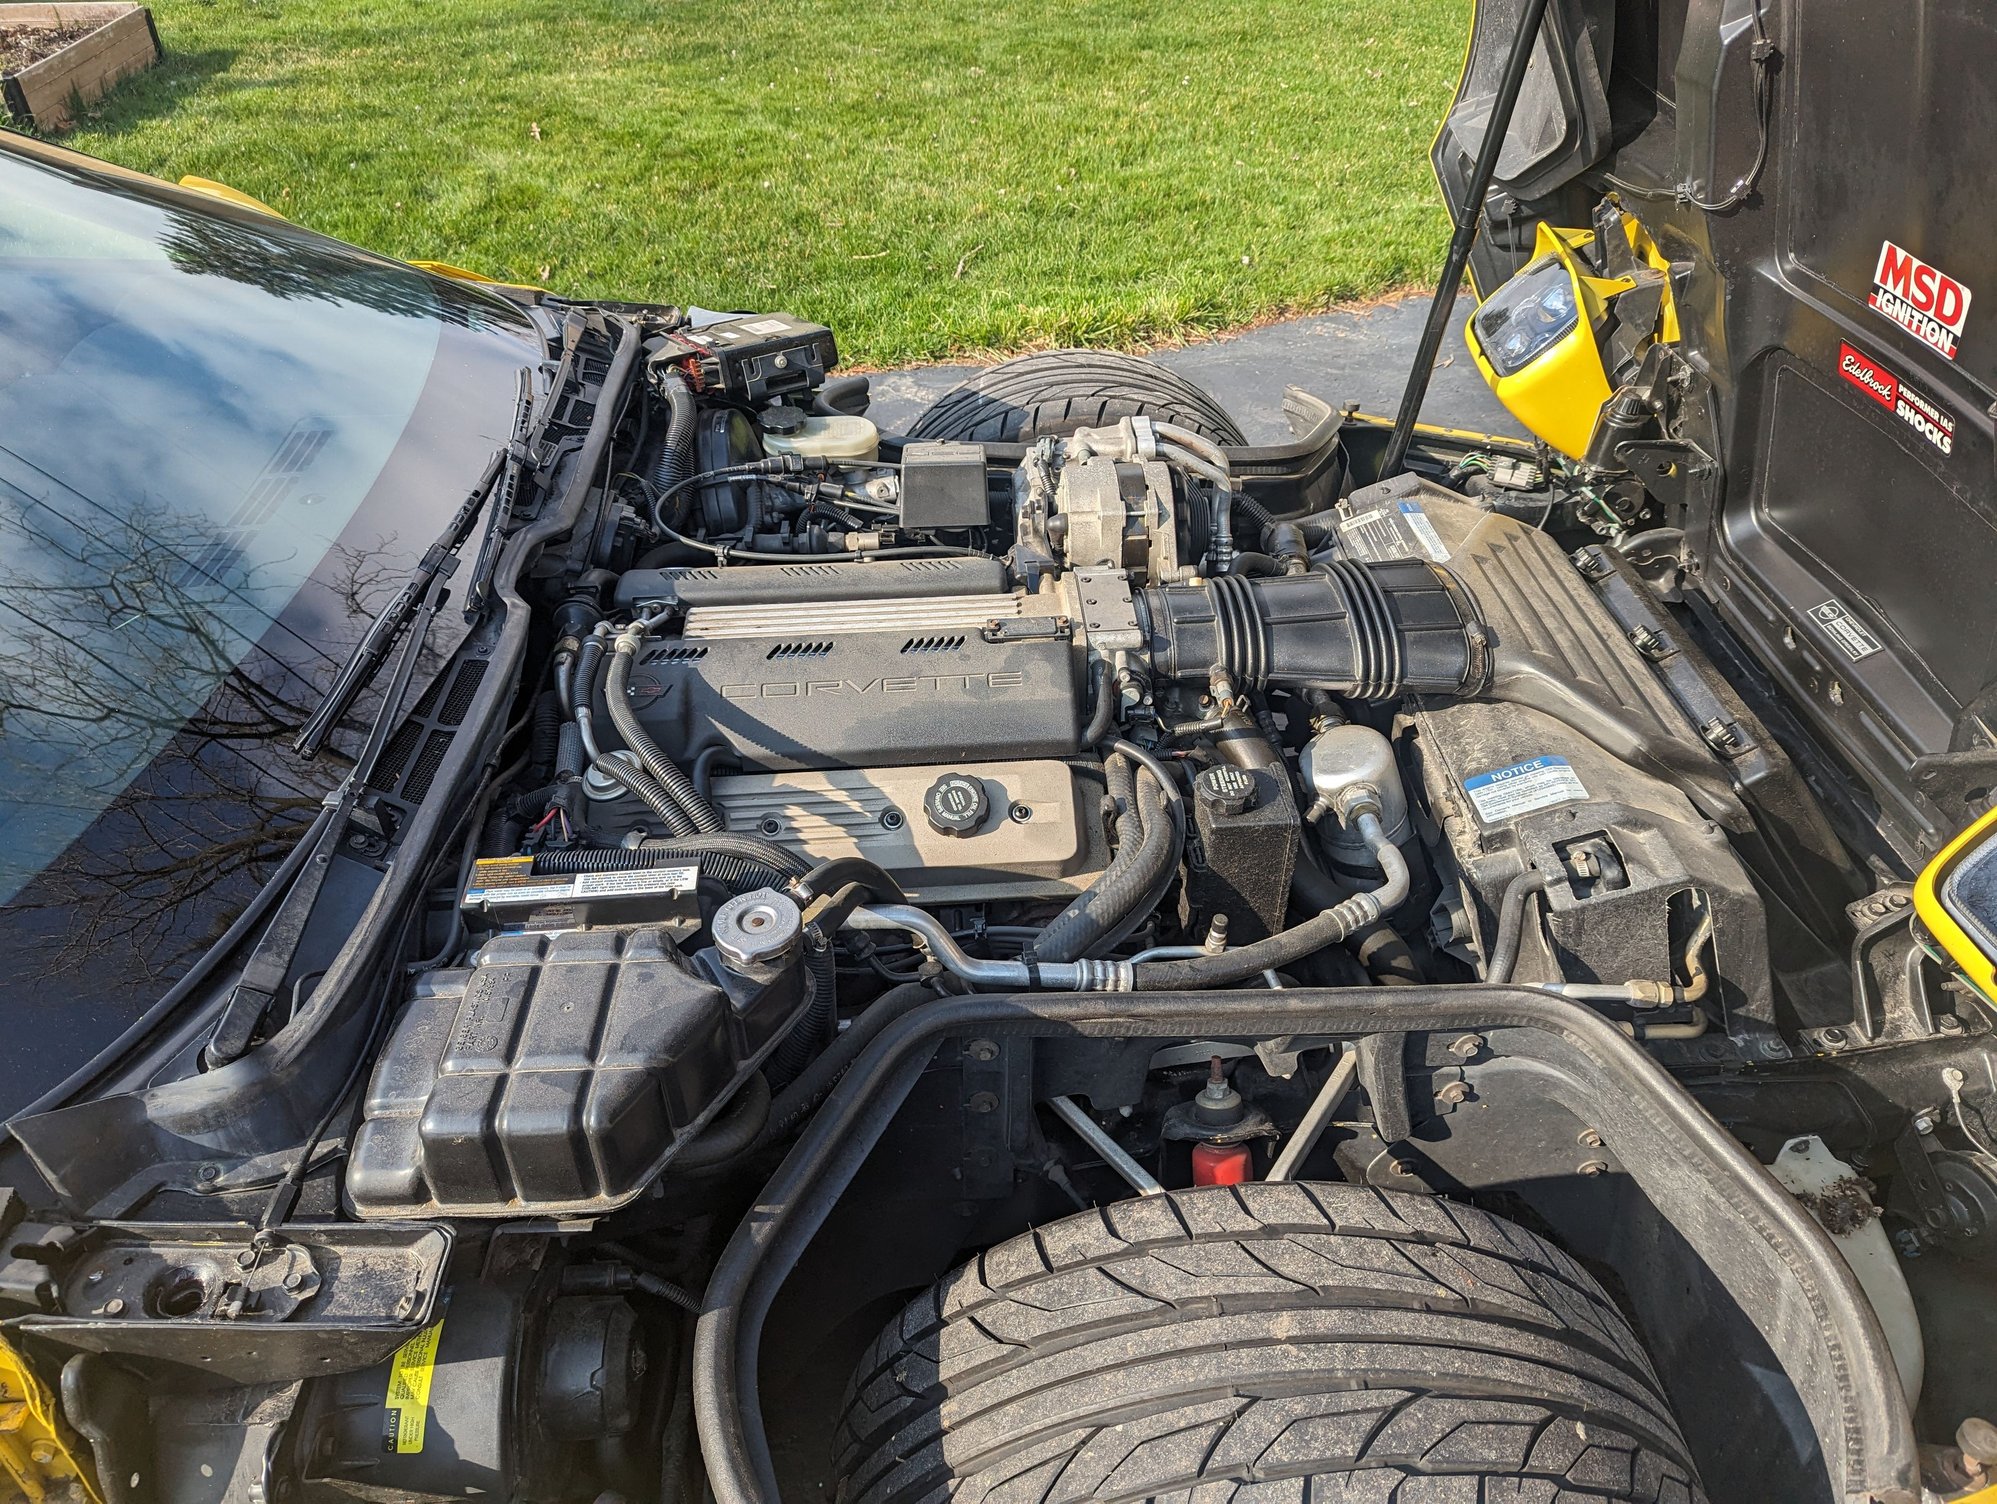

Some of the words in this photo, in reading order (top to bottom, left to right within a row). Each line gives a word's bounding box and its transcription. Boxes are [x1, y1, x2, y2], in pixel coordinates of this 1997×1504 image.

[1880, 244, 1963, 327] MSD
[1875, 288, 1954, 353] IGNITION
[1842, 355, 1892, 401] Edelbrock
[1896, 399, 1952, 454] SHOCKS
[1898, 383, 1940, 423] PERFORMER
[1940, 416, 1953, 432] IAS
[1835, 621, 1869, 652] CORVETTE
[721, 671, 1023, 699] CORVETTE
[1490, 760, 1544, 781] NOTICE
[388, 1410, 397, 1451] CAUTION
